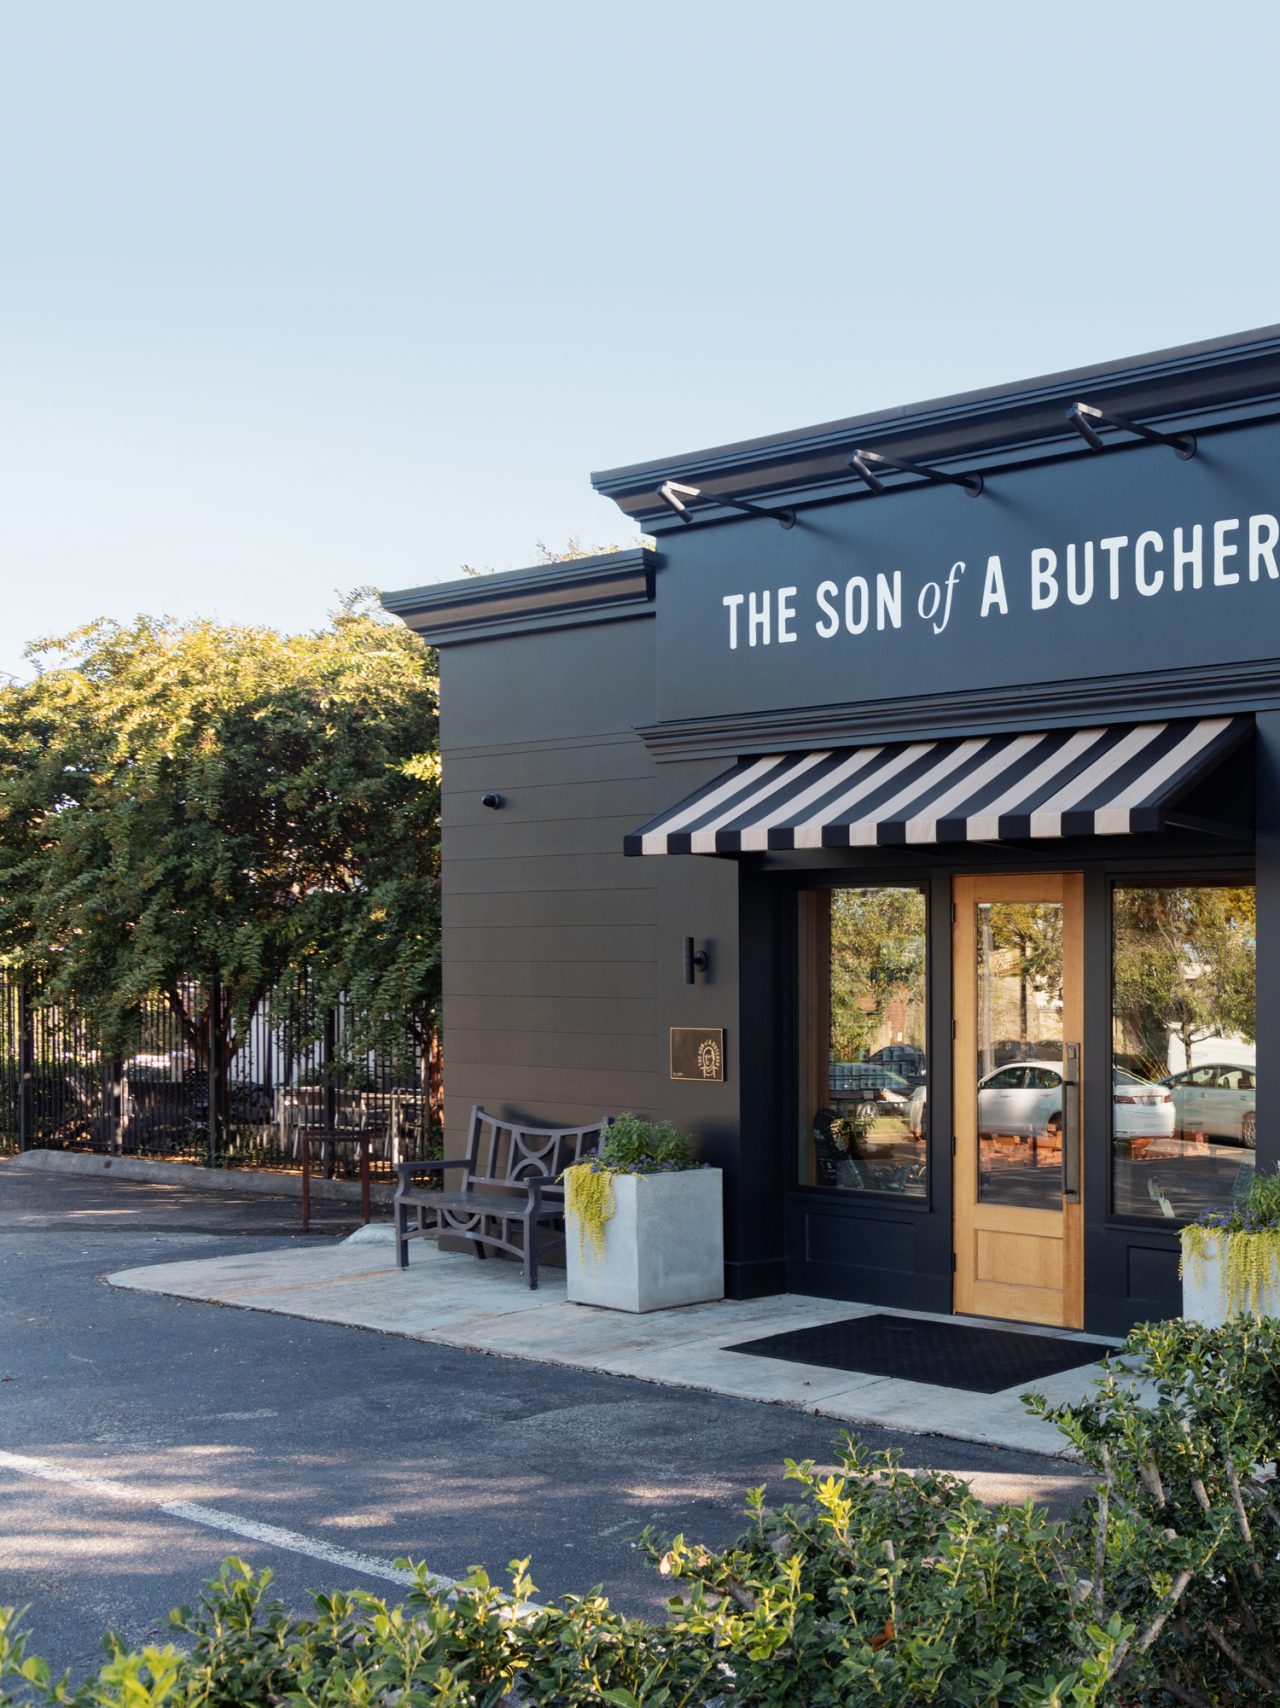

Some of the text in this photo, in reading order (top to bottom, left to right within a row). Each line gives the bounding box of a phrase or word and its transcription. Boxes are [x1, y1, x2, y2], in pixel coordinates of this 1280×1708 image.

[722, 513, 1280, 650] THE SON of A BUTCHER
